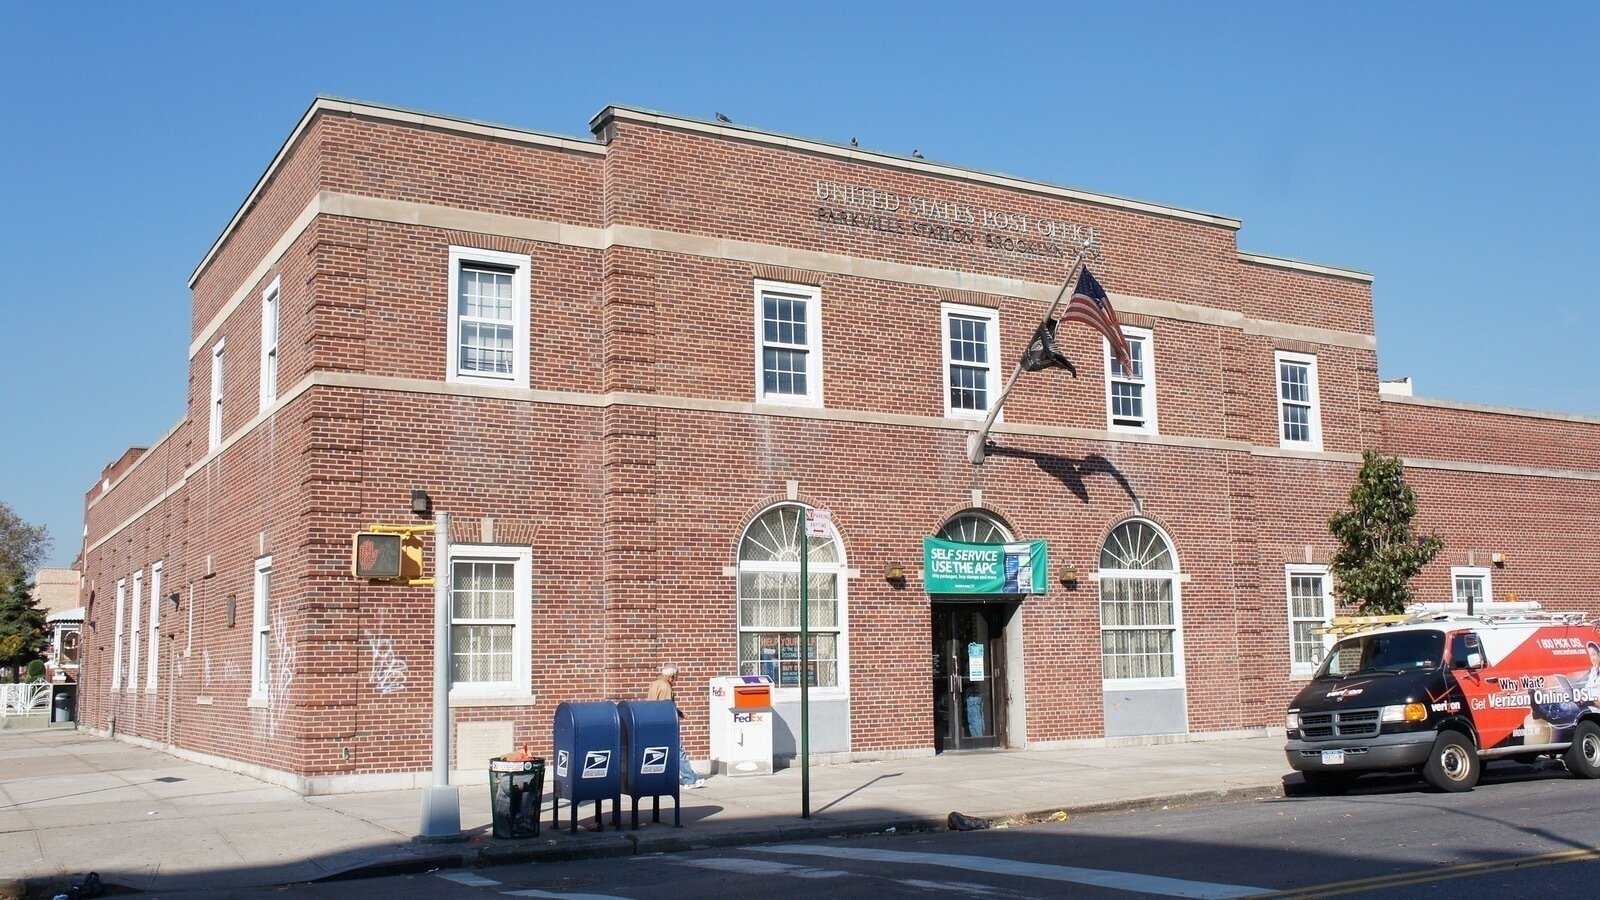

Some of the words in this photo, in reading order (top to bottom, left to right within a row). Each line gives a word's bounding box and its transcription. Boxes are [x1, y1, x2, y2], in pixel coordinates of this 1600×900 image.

[815, 180, 900, 213] UNITED
[908, 195, 975, 224] STATES
[983, 208, 1030, 233] POST
[1037, 217, 1099, 245] OFFICE
[817, 207, 905, 235] PARKVILLE
[911, 221, 974, 245] STATION
[985, 234, 1064, 259] BROOKLYN
[931, 548, 954, 560] SELF
[955, 549, 998, 561] SERVICE
[931, 561, 952, 573] USE
[952, 561, 973, 573] THE
[975, 562, 997, 574] APC
[1541, 638, 1554, 649] 800
[1553, 637, 1571, 649] PICK
[1569, 637, 1585, 648] DSL
[1500, 678, 1519, 691] Why
[1520, 676, 1545, 689] Wait?
[712, 686, 726, 697] FedEx
[1326, 688, 1363, 698] verizon
[1471, 698, 1486, 710] Get
[1488, 693, 1531, 708] Verizon
[1534, 690, 1570, 705] Online
[1573, 687, 1598, 702] DSL.
[1431, 700, 1460, 712] verizon
[734, 713, 763, 723] FedEx
